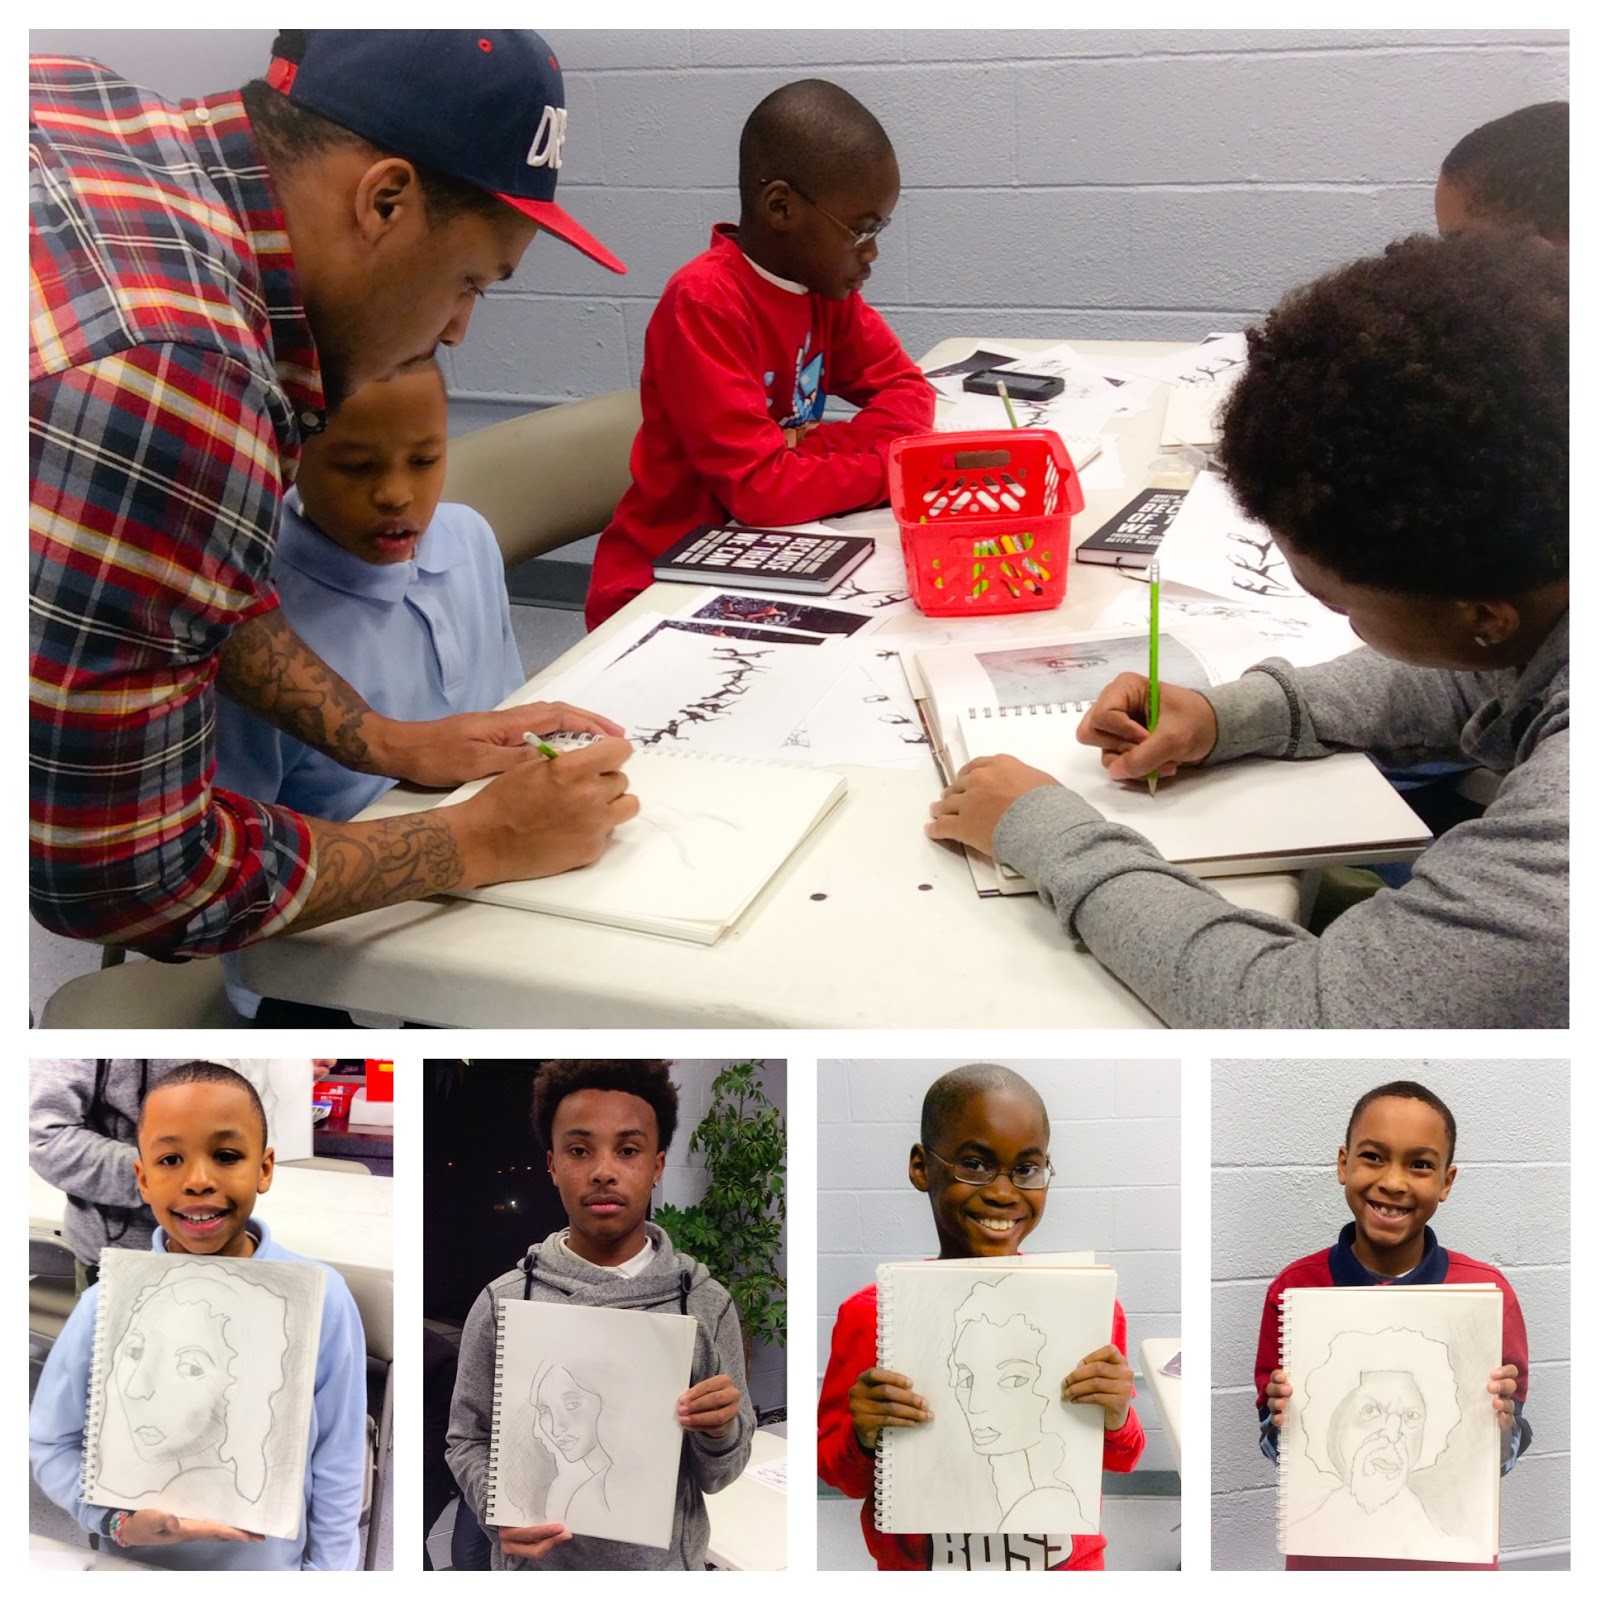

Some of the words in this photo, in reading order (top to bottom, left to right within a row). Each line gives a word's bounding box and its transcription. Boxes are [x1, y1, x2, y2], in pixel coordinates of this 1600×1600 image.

[1126, 512, 1159, 523] OF
[1116, 523, 1158, 534] WE
[701, 546, 744, 566] CAN
[760, 537, 822, 571] BECAUSE
